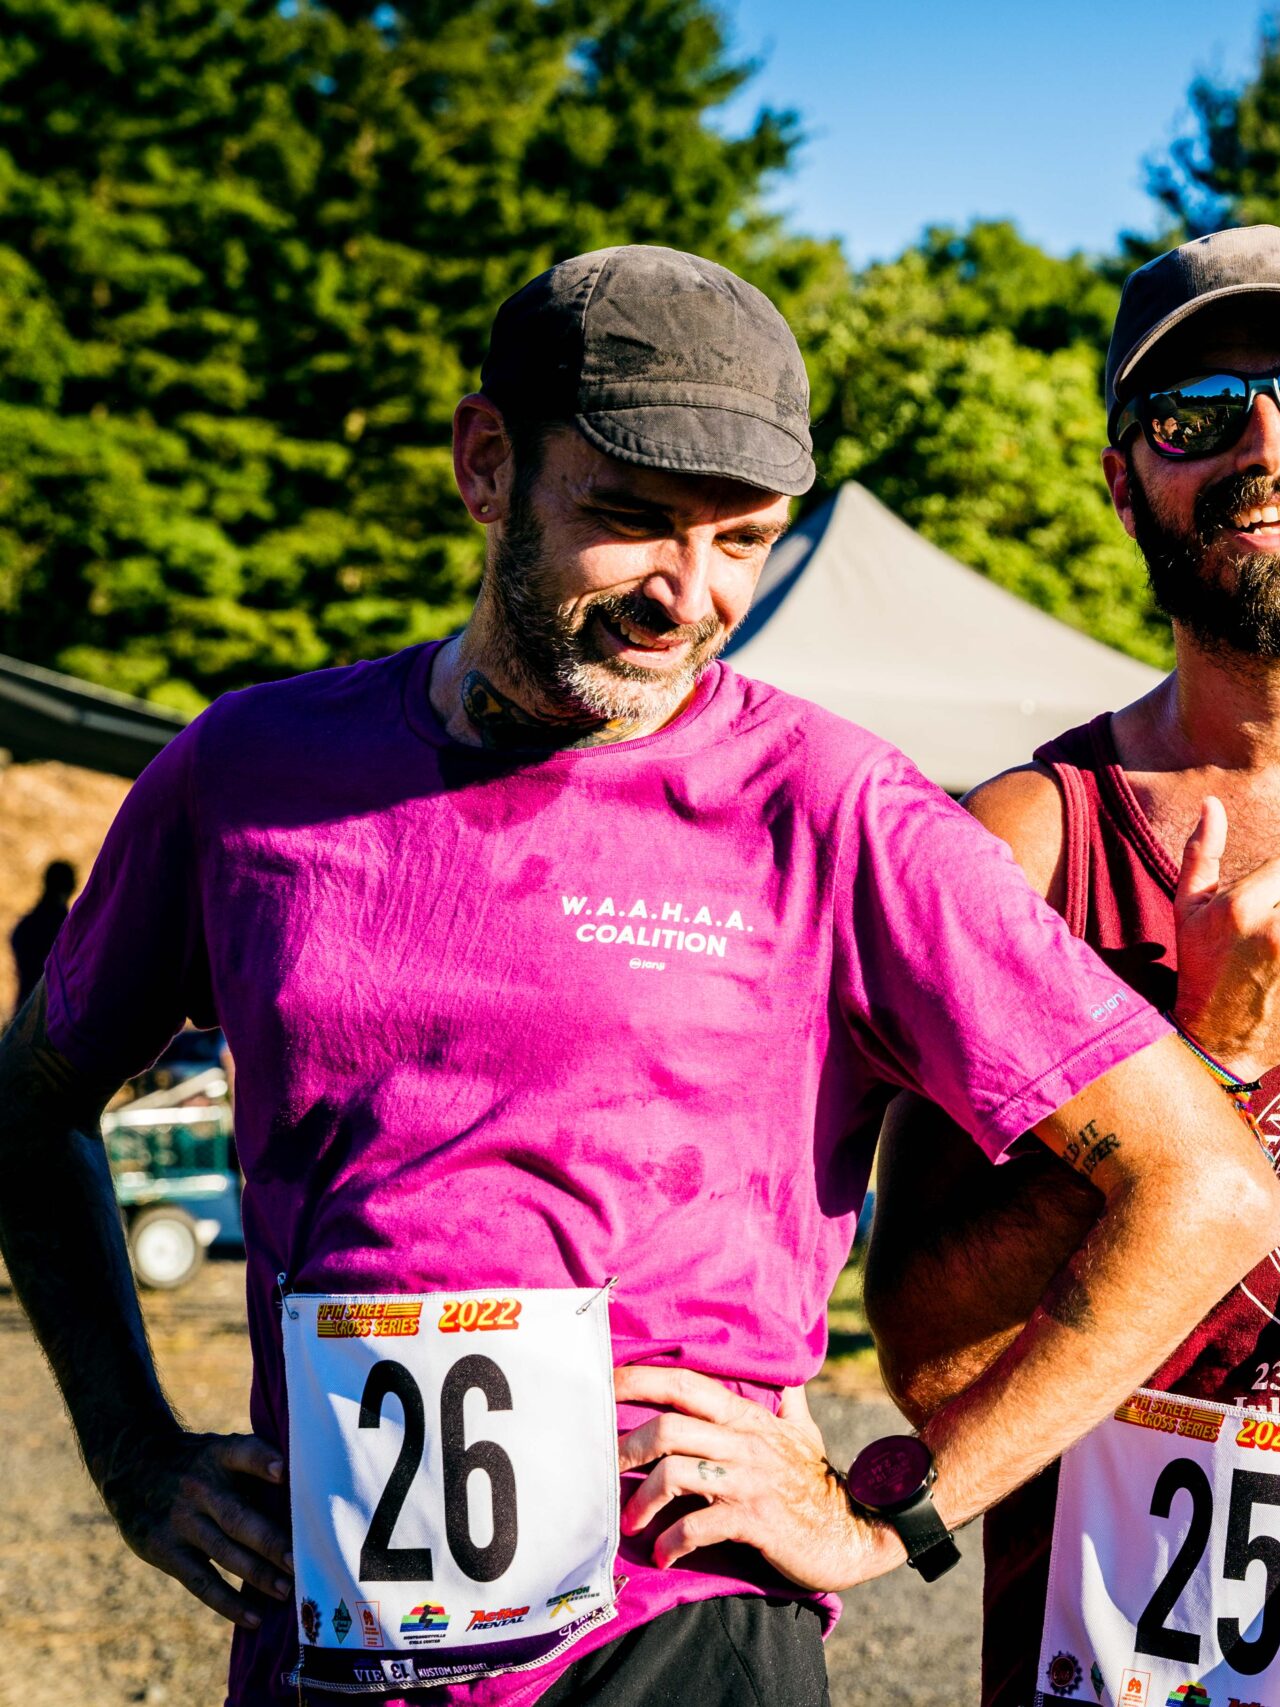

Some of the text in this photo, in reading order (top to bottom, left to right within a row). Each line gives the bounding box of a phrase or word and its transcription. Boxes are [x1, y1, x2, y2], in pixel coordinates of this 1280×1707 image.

[561, 895, 754, 933] W.A.A.H.A.A.
[576, 923, 728, 958] COALITION
[317, 1298, 522, 1333] FIFTH STREET 2022
[334, 1318, 420, 1337] CROSS SERIES
[1150, 1396, 1194, 1421] STREET
[1138, 1409, 1219, 1442] CROSS SERIES
[358, 1353, 519, 1583] 26
[472, 1616, 525, 1631] RENTAL
[353, 1668, 385, 1682] VIE
[417, 1665, 452, 1679] KUSTOM
[451, 1662, 490, 1675] APPAREL
